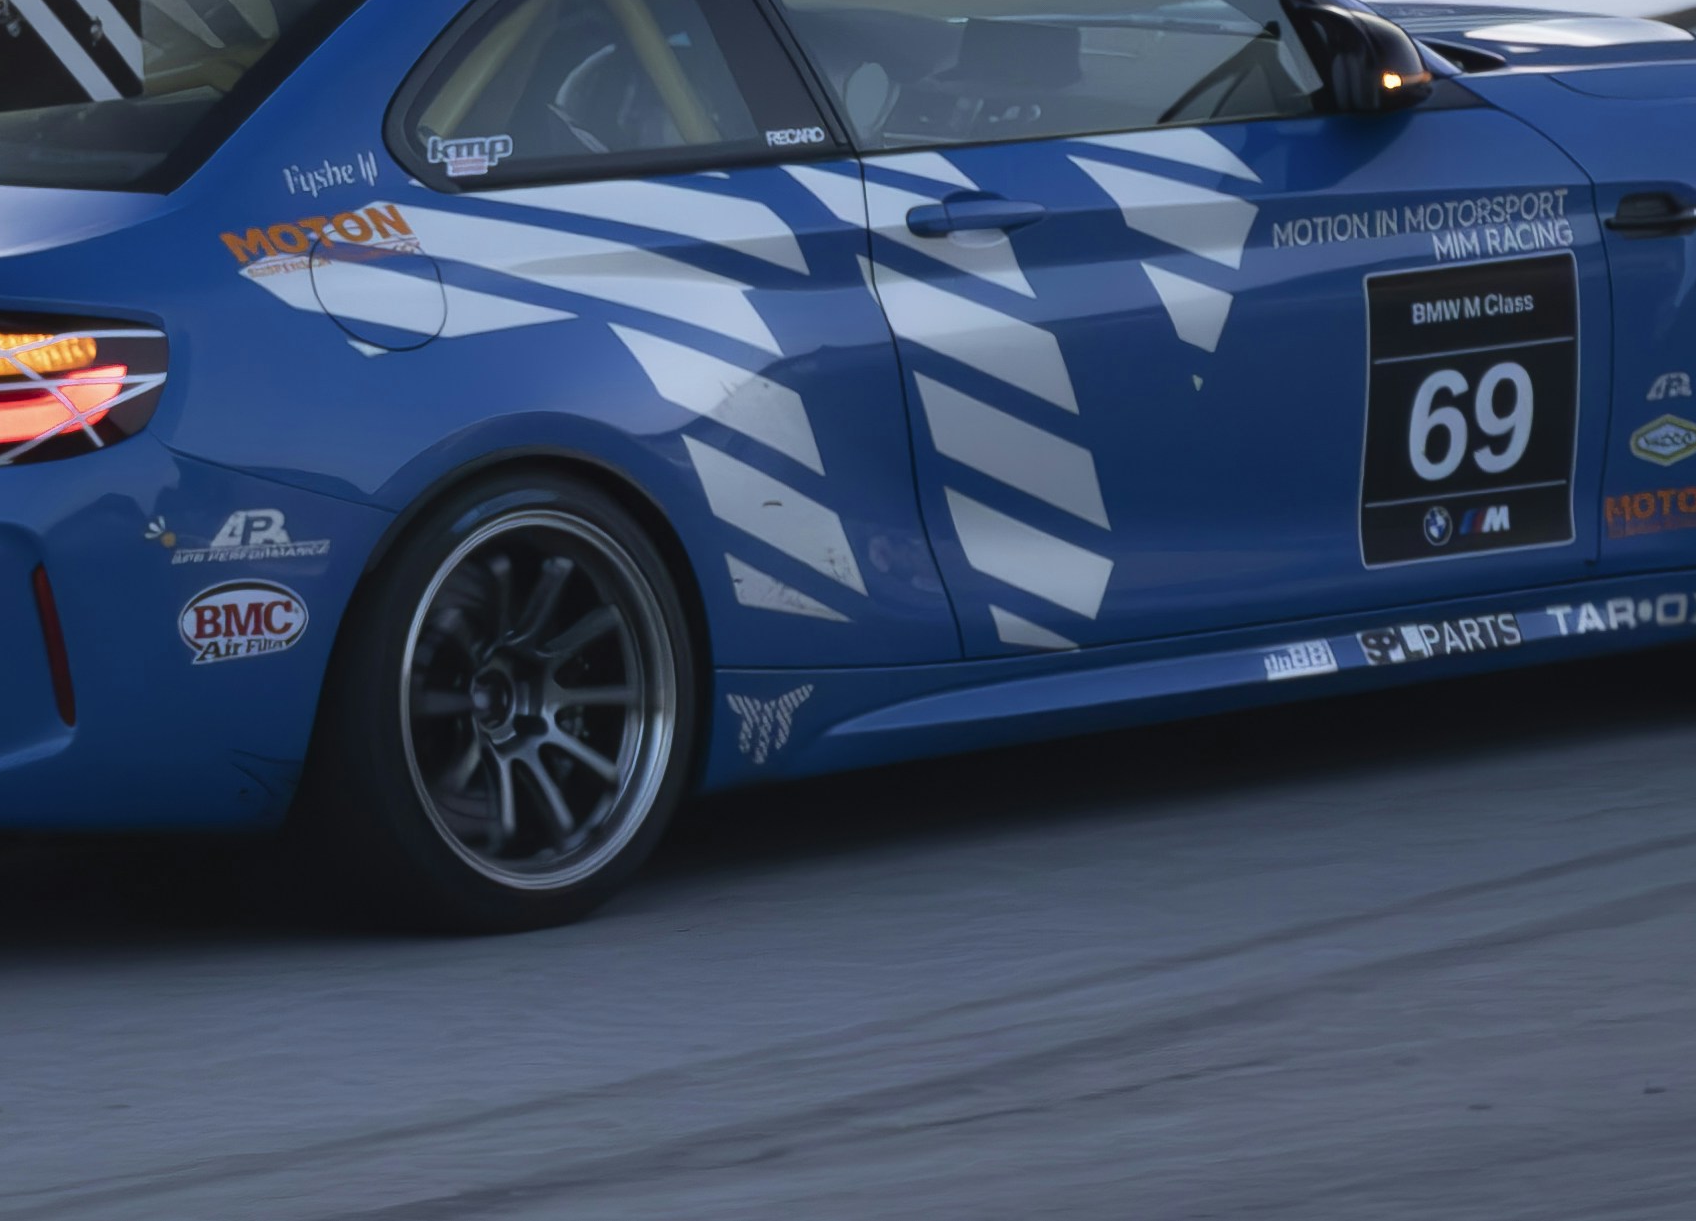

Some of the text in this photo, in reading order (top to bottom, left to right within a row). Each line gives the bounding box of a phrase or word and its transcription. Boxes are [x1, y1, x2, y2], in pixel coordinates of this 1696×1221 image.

[220, 204, 414, 263] MOTON
[1272, 189, 1568, 249] MOTION IN MOTORSPORT
[1432, 218, 1573, 261] MIM RACING
[1411, 294, 1534, 325] BMW M Class
[1408, 362, 1534, 481] 69
[193, 600, 293, 640] BMC
[1419, 613, 1521, 660] PARTS
[195, 639, 242, 662] Air
